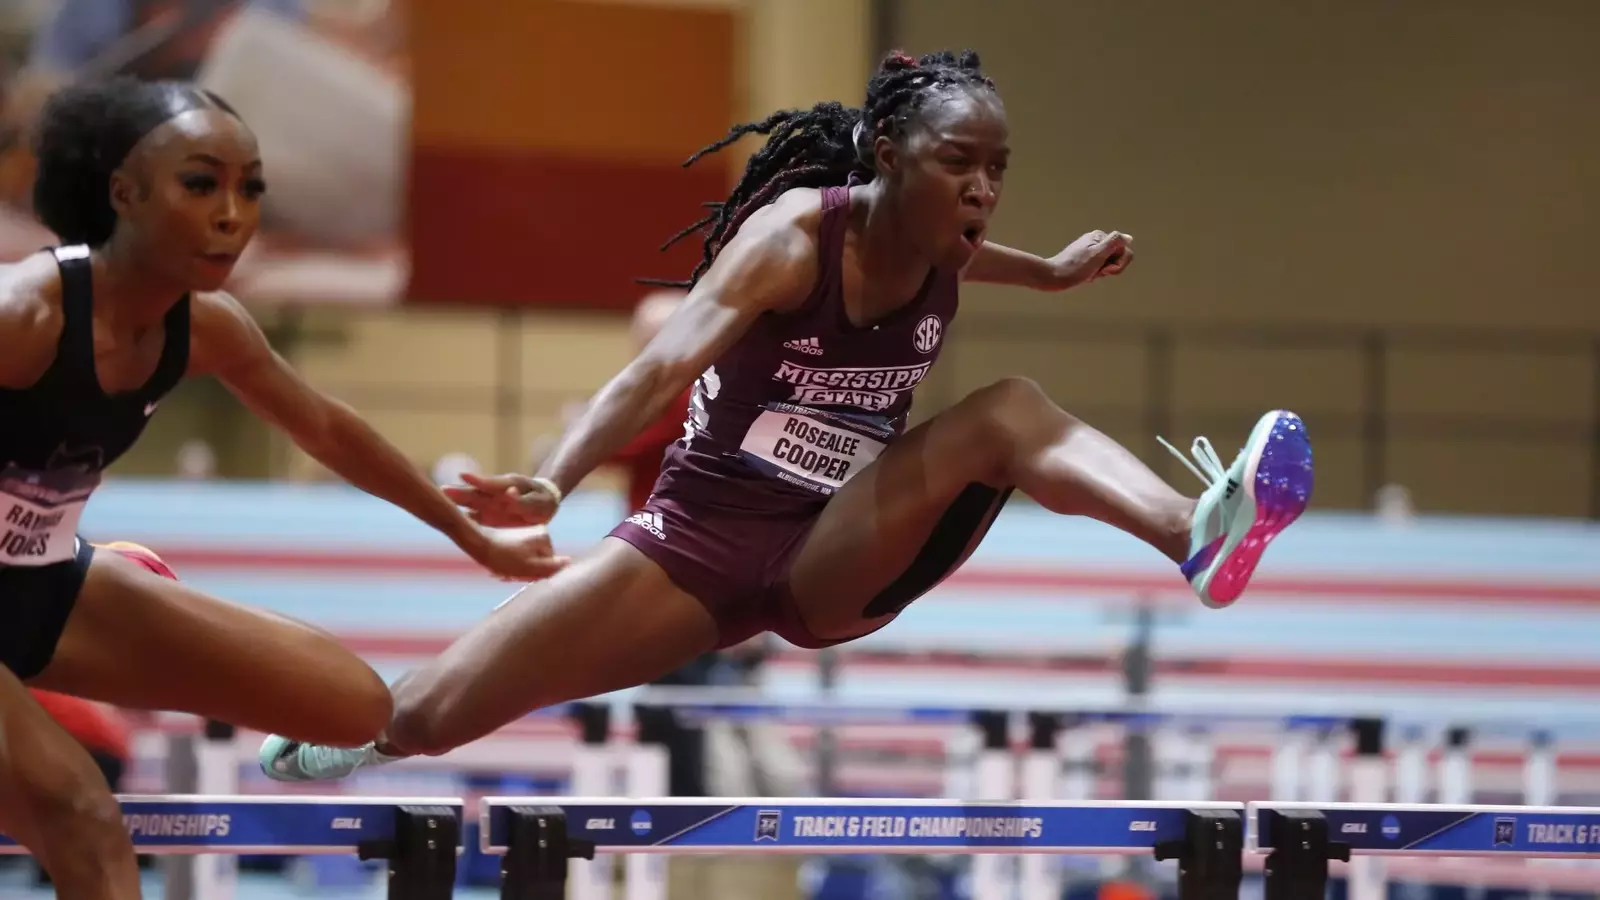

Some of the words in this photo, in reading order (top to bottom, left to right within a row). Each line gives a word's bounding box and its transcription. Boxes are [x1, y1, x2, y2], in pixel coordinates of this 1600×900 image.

[916, 317, 941, 351] SEC
[783, 417, 860, 456] ROSEALEE
[772, 438, 850, 482] COOPER
[331, 817, 362, 829] GILL
[586, 818, 615, 830] GILL
[794, 816, 847, 837] TRACK
[847, 816, 860, 837] &
[861, 816, 906, 837] FIELD
[909, 816, 1043, 838] CHAMPIONSHIPS
[1129, 820, 1157, 831] GILL
[1528, 823, 1576, 844] TRACK
[1575, 824, 1588, 845] &
